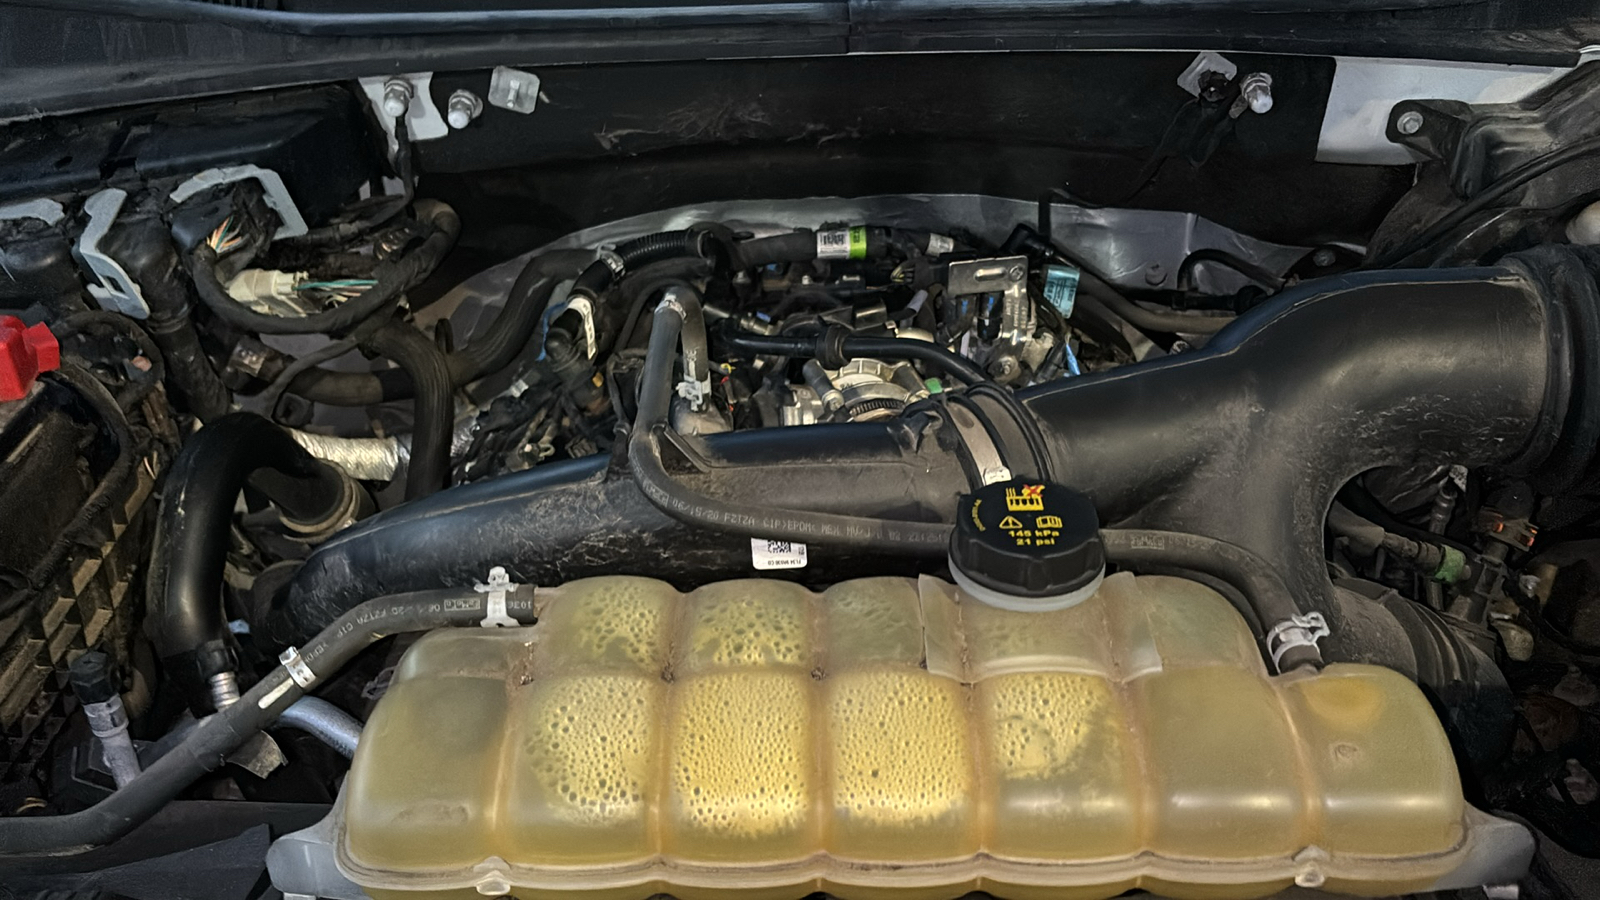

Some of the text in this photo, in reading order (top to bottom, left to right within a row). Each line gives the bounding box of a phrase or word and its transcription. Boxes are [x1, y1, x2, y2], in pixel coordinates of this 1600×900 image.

[1035, 530, 1060, 538] kPa
[1016, 538, 1055, 547] 21 psi
